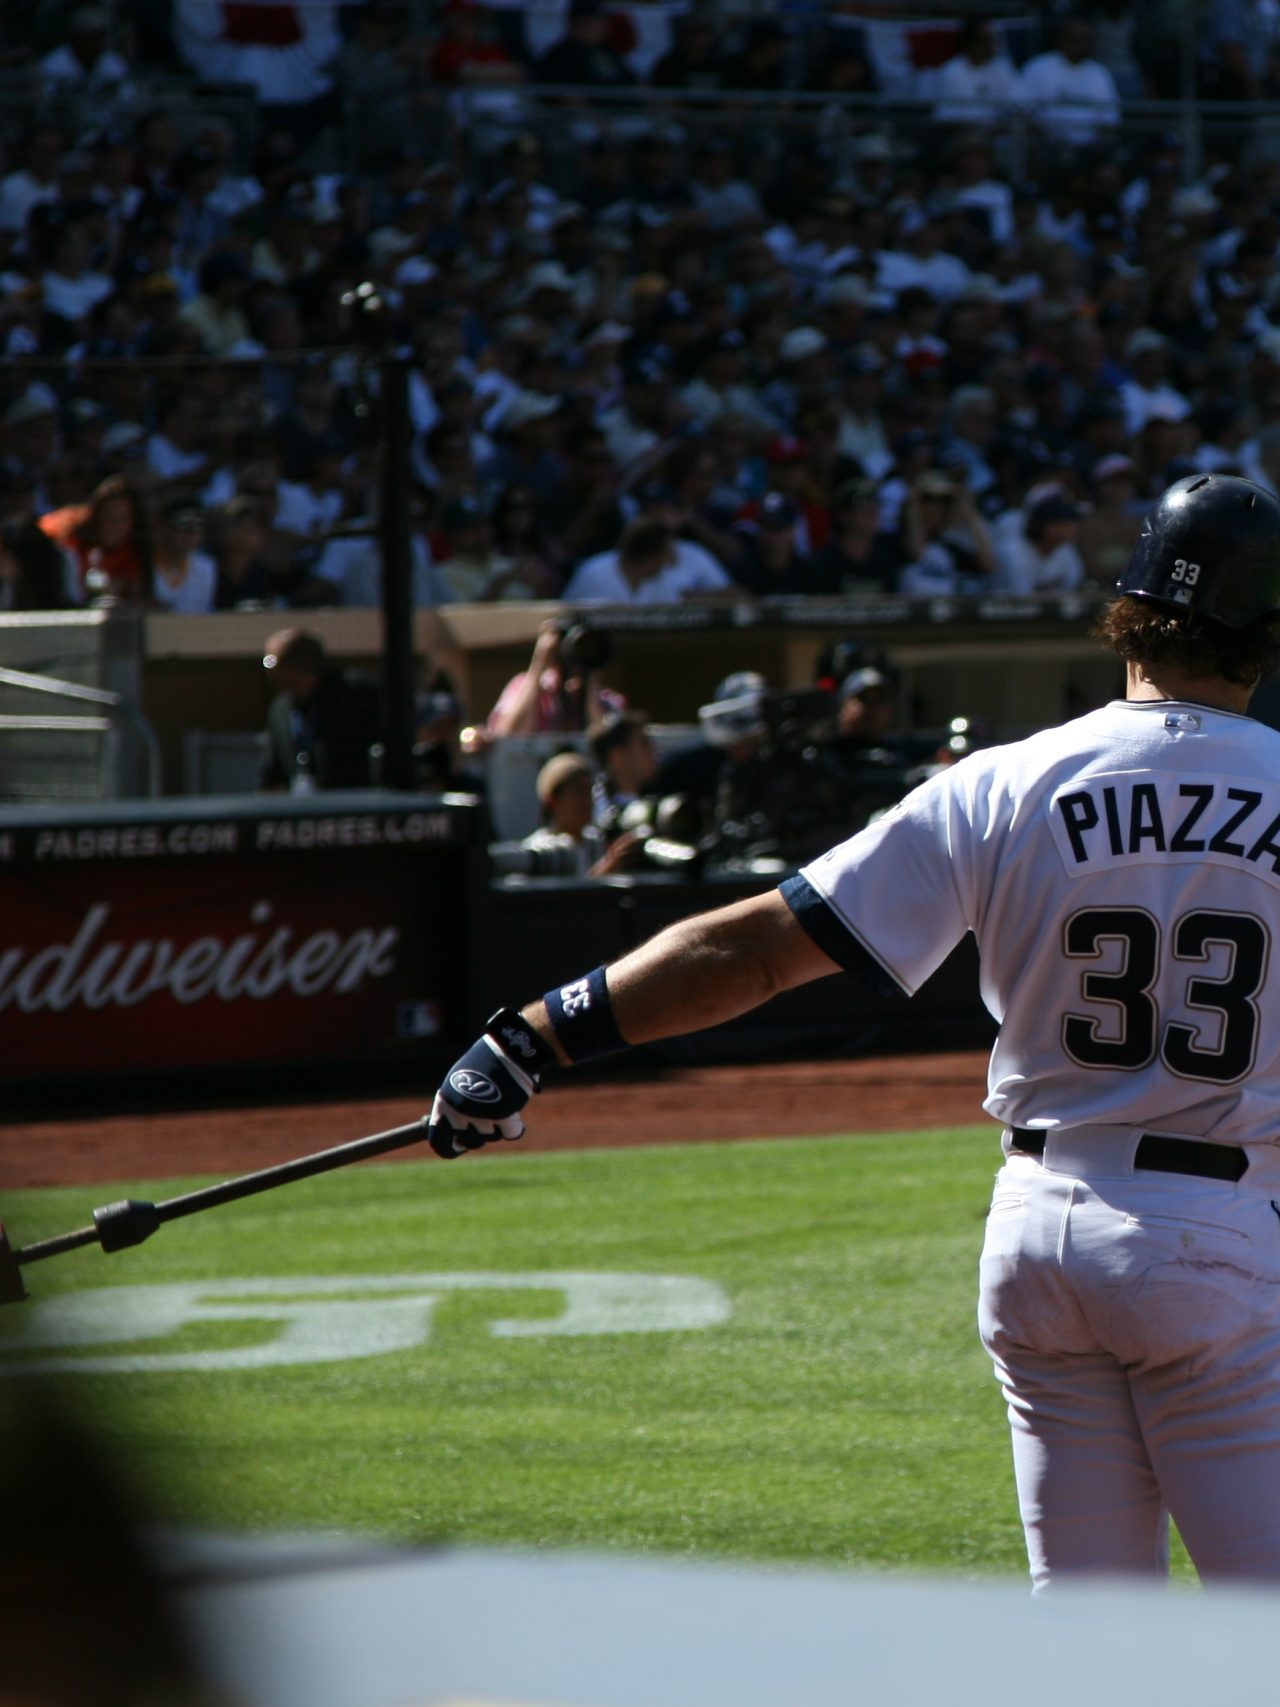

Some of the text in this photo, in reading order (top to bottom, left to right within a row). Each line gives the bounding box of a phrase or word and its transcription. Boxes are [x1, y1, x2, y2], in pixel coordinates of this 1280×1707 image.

[1171, 558, 1200, 585] 33
[34, 823, 240, 861] PADRES.COM
[560, 978, 592, 1019] 33
[1061, 905, 1272, 1086] 33
